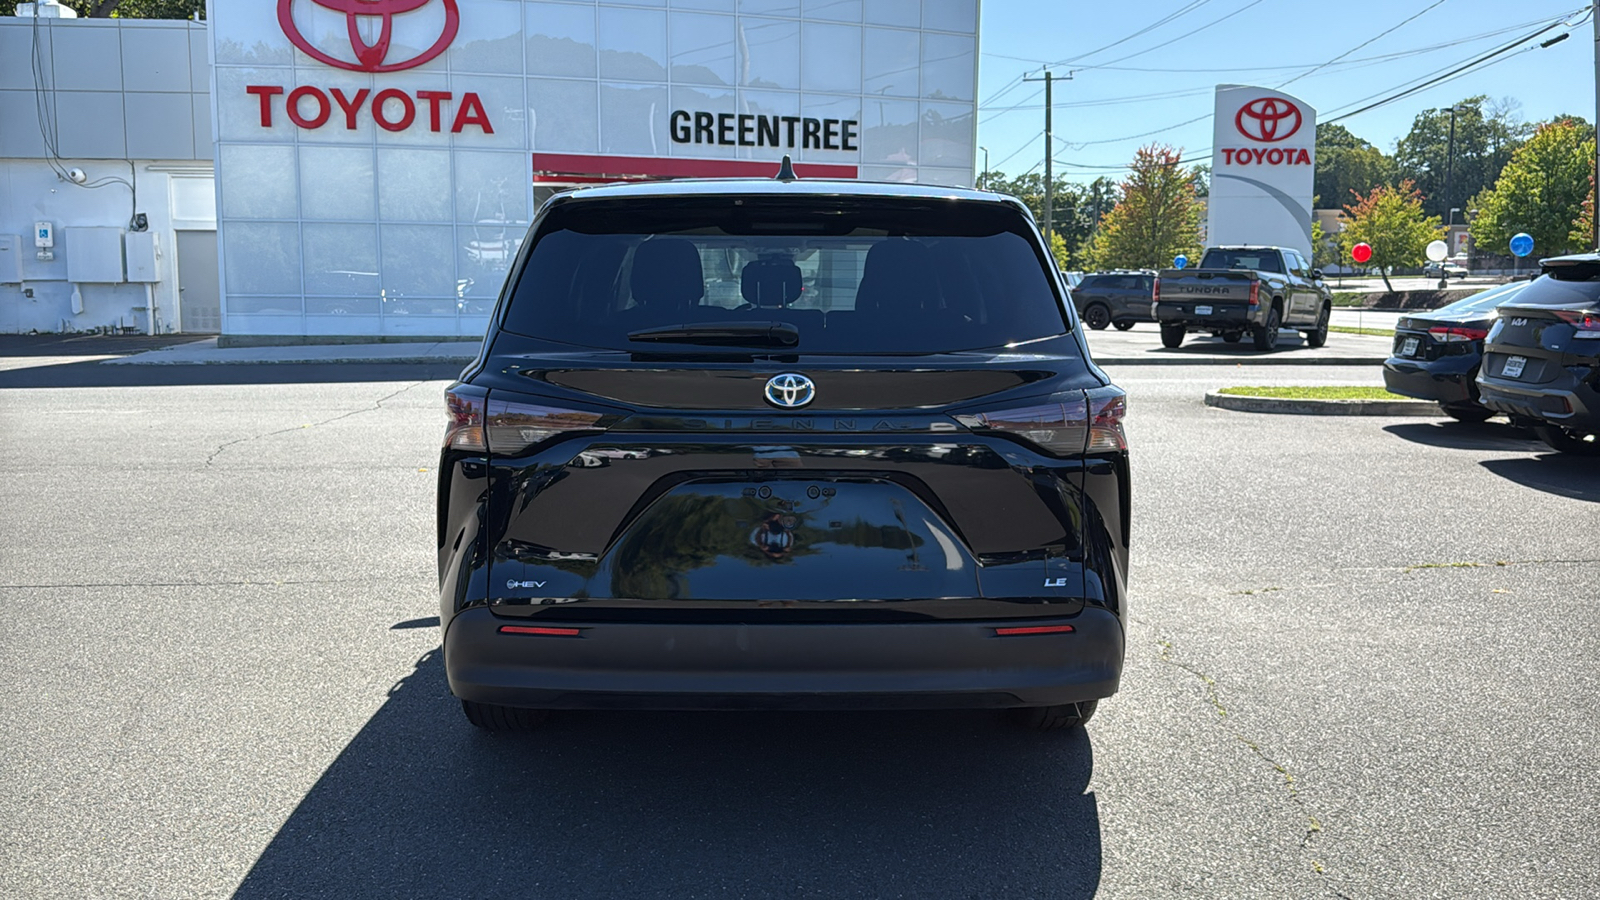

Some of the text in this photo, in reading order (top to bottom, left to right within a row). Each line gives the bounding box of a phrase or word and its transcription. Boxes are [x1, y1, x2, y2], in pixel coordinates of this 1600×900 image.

[246, 85, 495, 134] TOYOTA
[670, 110, 858, 151] GREENTREE
[1221, 148, 1311, 165] TOYOTA
[1180, 286, 1230, 294] TUNDRA
[683, 419, 897, 430] SIENNA
[513, 580, 548, 588] HEV
[1044, 577, 1067, 587] LE
